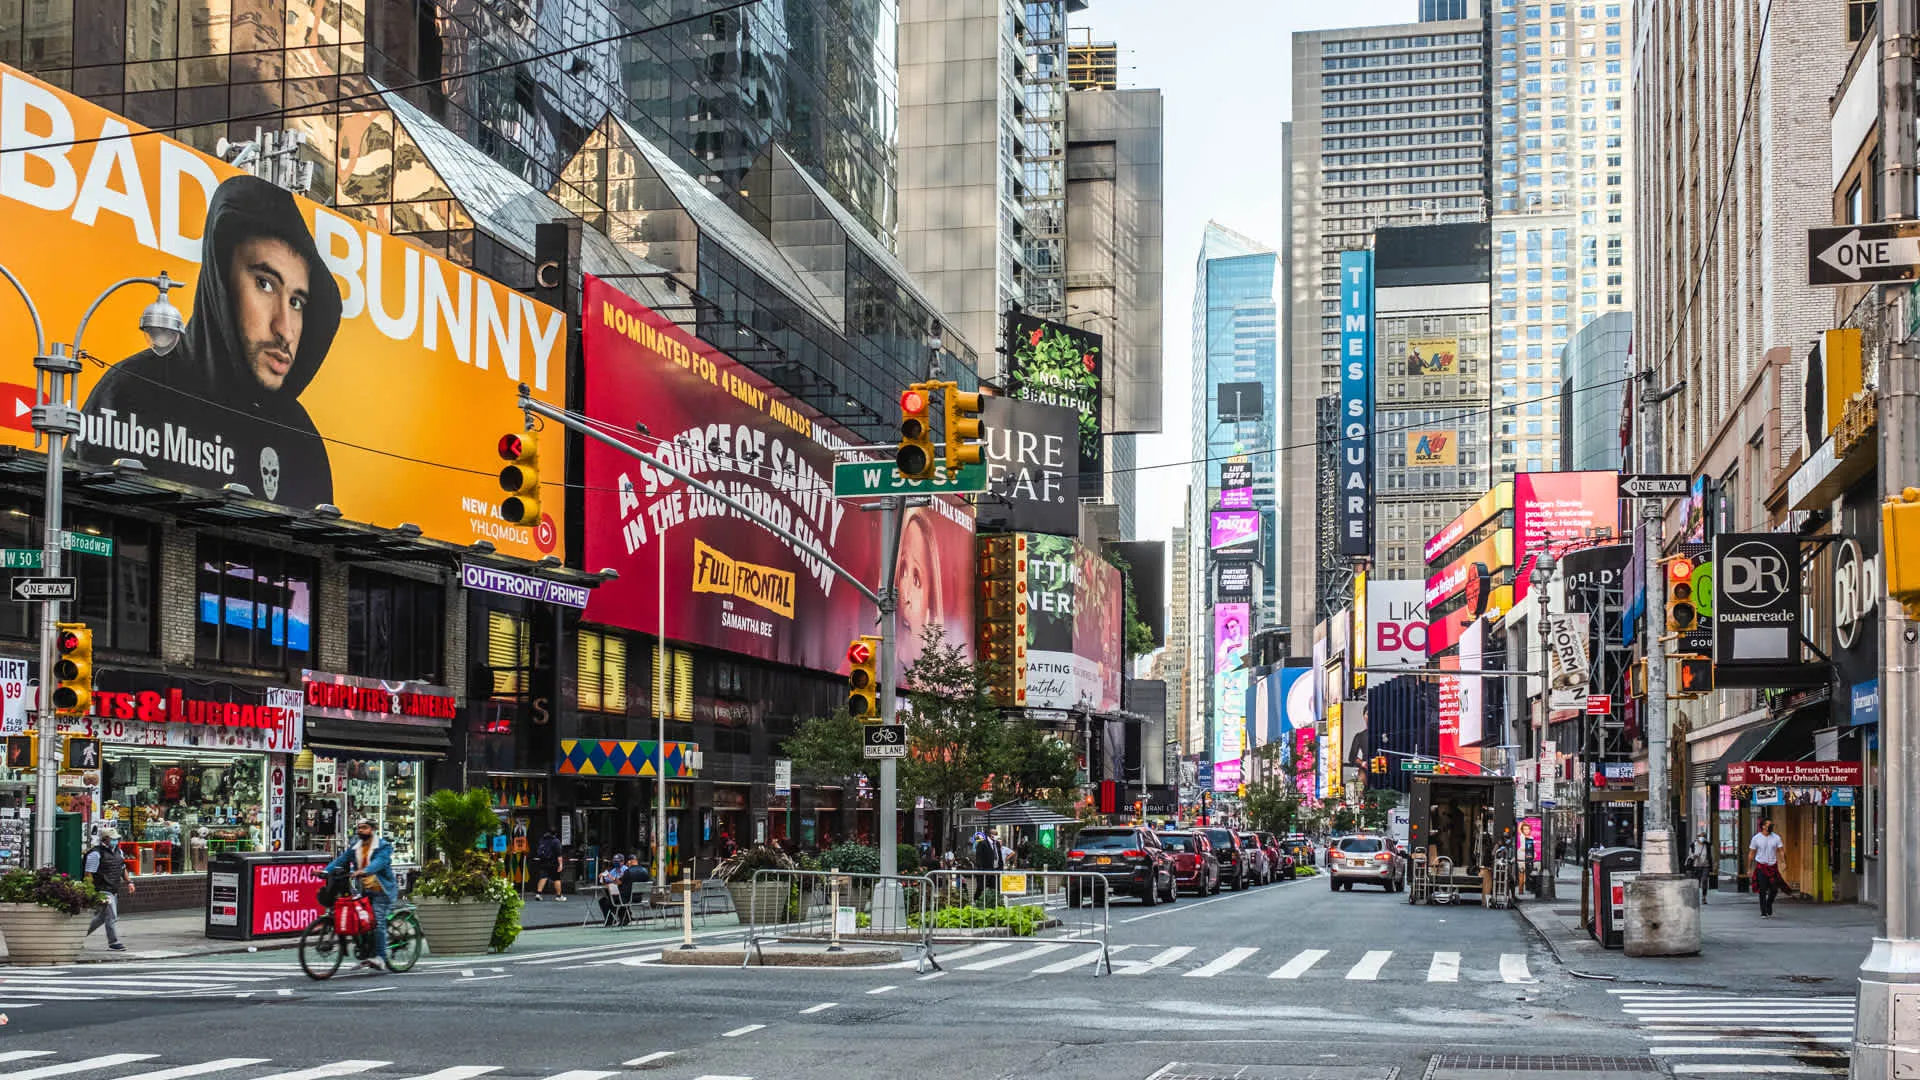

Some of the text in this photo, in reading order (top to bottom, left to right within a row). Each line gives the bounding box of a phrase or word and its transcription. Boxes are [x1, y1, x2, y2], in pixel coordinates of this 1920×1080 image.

[1, 71, 564, 391] BAD BUNNY
[1838, 242, 1890, 266] ONE
[602, 300, 690, 368] NOMINATED
[692, 351, 718, 386] FOR
[721, 370, 729, 392] 4
[769, 398, 811, 438] AWARDS
[1064, 379, 1076, 392] IS
[1022, 386, 1093, 415] BEAUTIFUL
[1345, 266, 1365, 538] TIMES SQUARE
[66, 400, 235, 475] ouTube Music
[618, 424, 844, 548] A SOURCE OF SANITY
[863, 469, 881, 488] W
[1631, 481, 1680, 491] ONE WAY
[462, 496, 487, 516] NEW
[939, 499, 954, 521] TALK
[470, 518, 528, 544] YHLQMDLG
[623, 514, 647, 555] IN
[649, 490, 684, 535] THE
[730, 480, 792, 548] HORROR
[793, 517, 837, 598] SHOW
[1321, 498, 1329, 569] AMERICAN
[1525, 529, 1546, 537] Mont
[71, 536, 111, 556] Broadway
[6, 552, 16, 566] W
[20, 553, 32, 566] 50
[466, 567, 586, 606] OUTFRONT PRIME
[698, 550, 791, 608] FULL FRONTAL
[1723, 556, 1789, 593] DR
[24, 584, 66, 594] ONE WAY
[721, 612, 773, 638] SAMANTHA BEE
[1017, 538, 1026, 701] BROOKLYN
[137, 690, 167, 722] &
[166, 688, 283, 730] LUGGAGE
[308, 681, 456, 719] COMPUTERS & CAMERAS
[865, 745, 903, 755] BIKE LANE
[1749, 765, 1764, 774] The
[1766, 765, 1785, 774] Anne
[1795, 765, 1830, 774] Bernstein
[1830, 765, 1858, 774] Theater
[1760, 774, 1848, 783] The Jerry Orbach Theater
[260, 865, 323, 886] EMBRACE
[281, 891, 299, 903] THE
[263, 908, 318, 931] ABSURD
